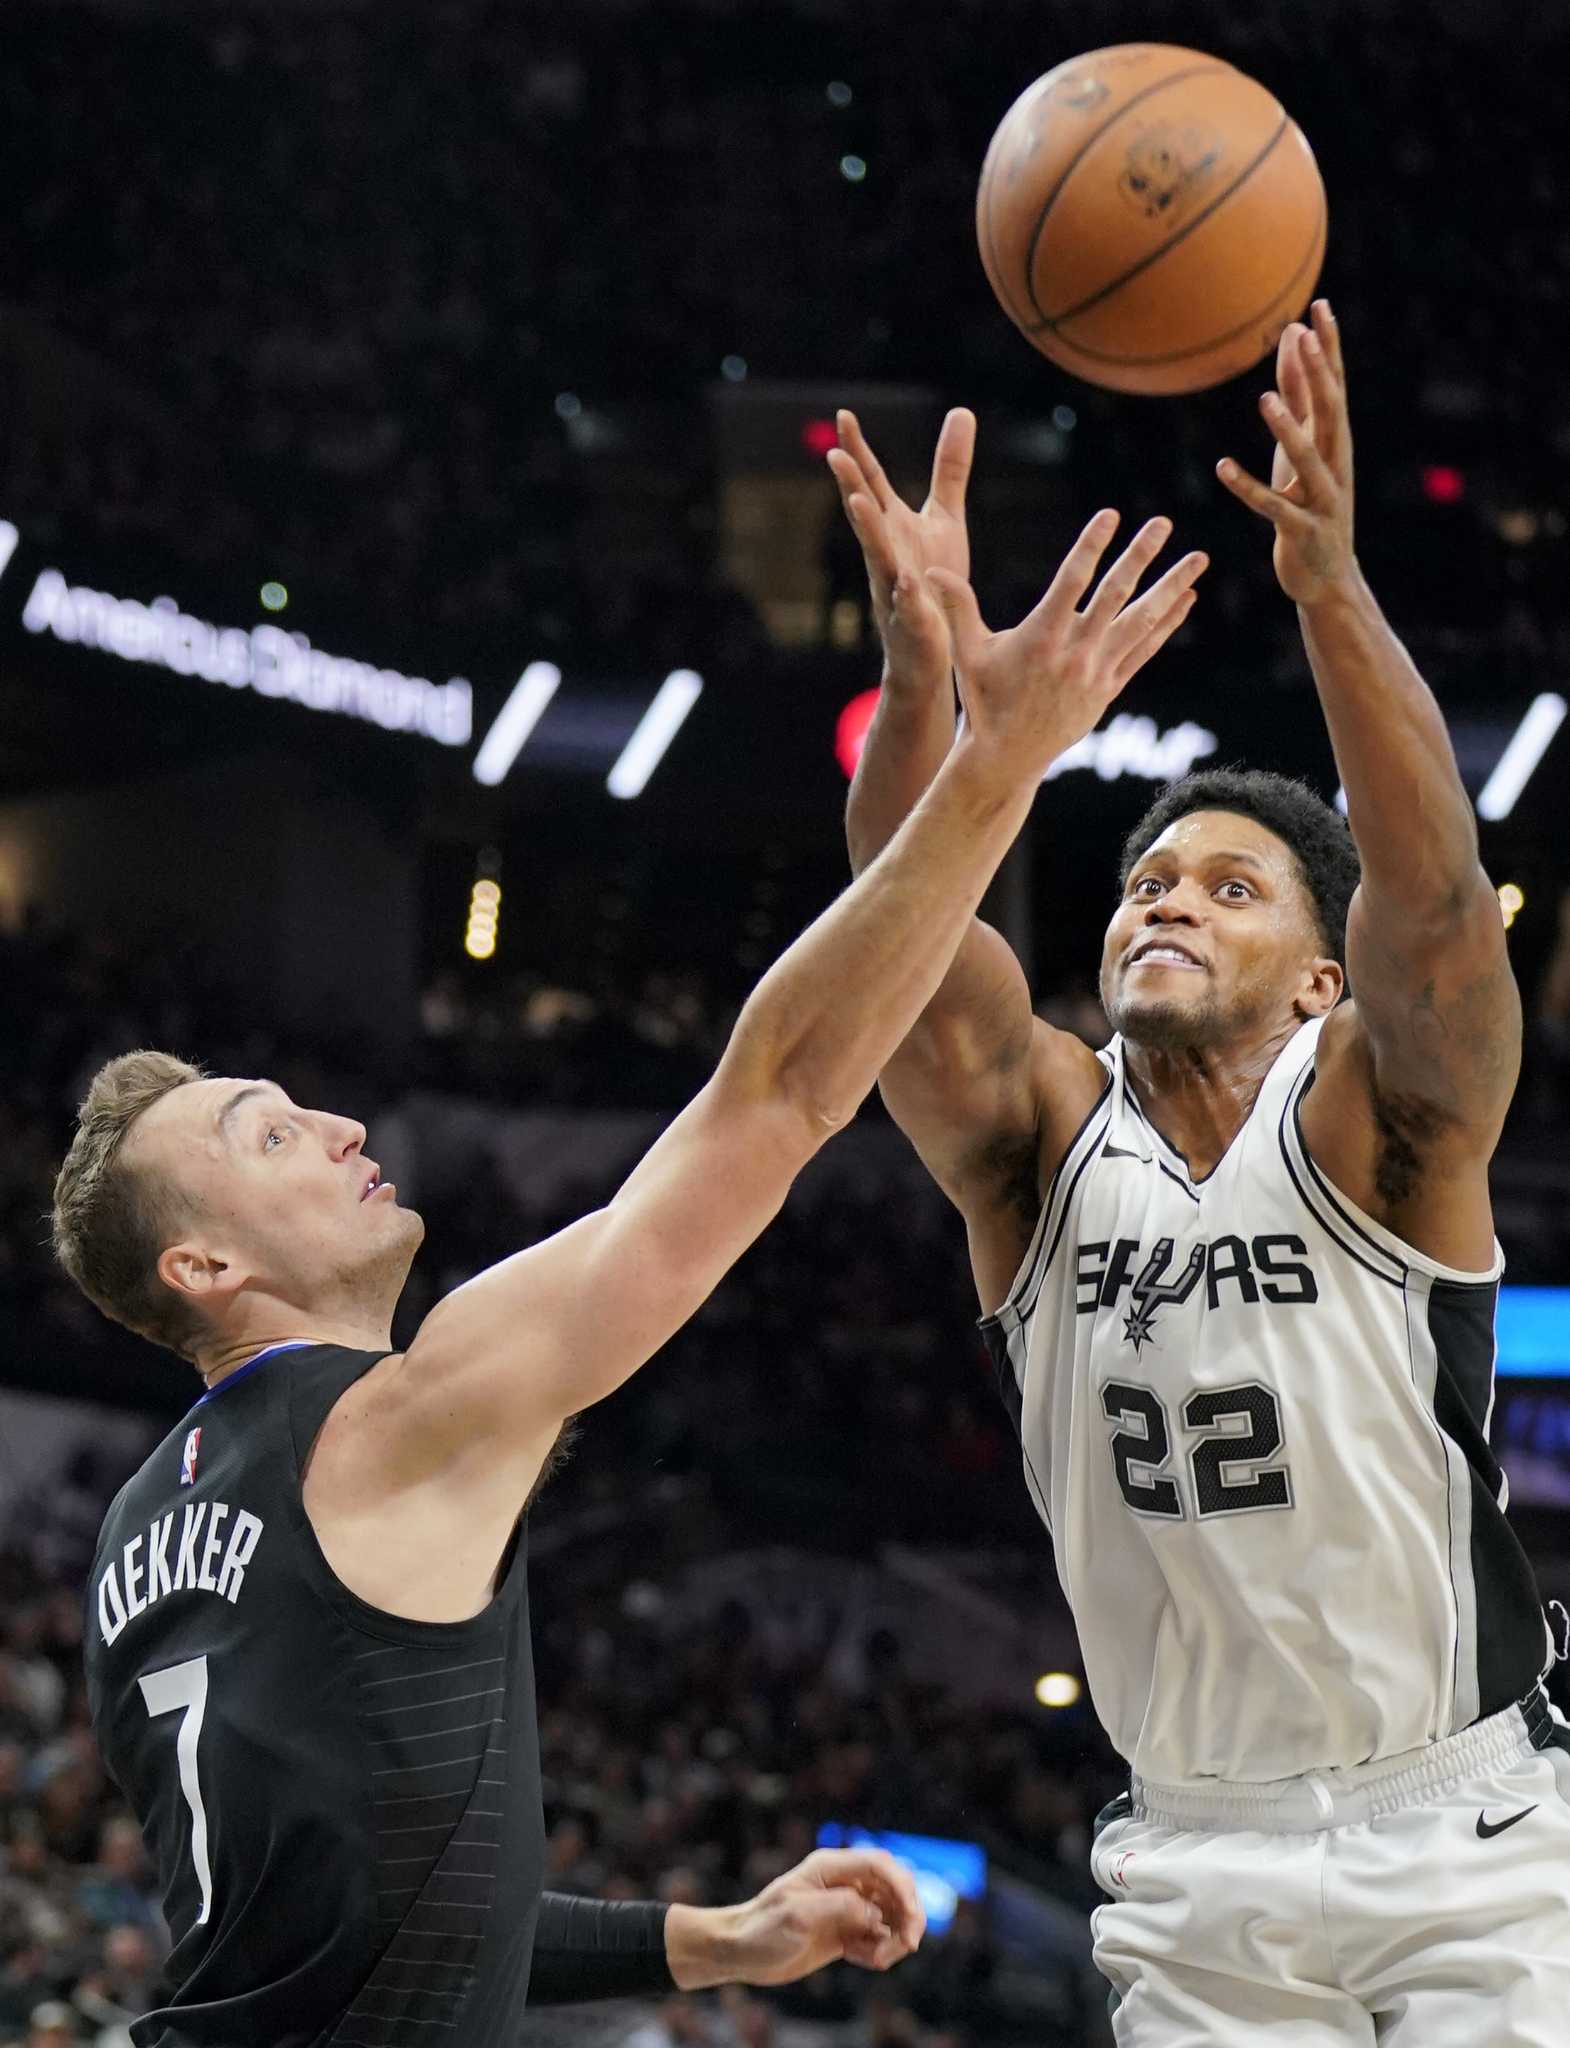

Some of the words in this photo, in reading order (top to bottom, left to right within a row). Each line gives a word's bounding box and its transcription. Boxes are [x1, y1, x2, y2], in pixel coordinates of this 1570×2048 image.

[1076, 1235, 1319, 1353] SPURS
[1099, 1379, 1294, 1521] 22
[98, 1502, 264, 1648] DEKKER
[138, 1655, 212, 1925] 7
